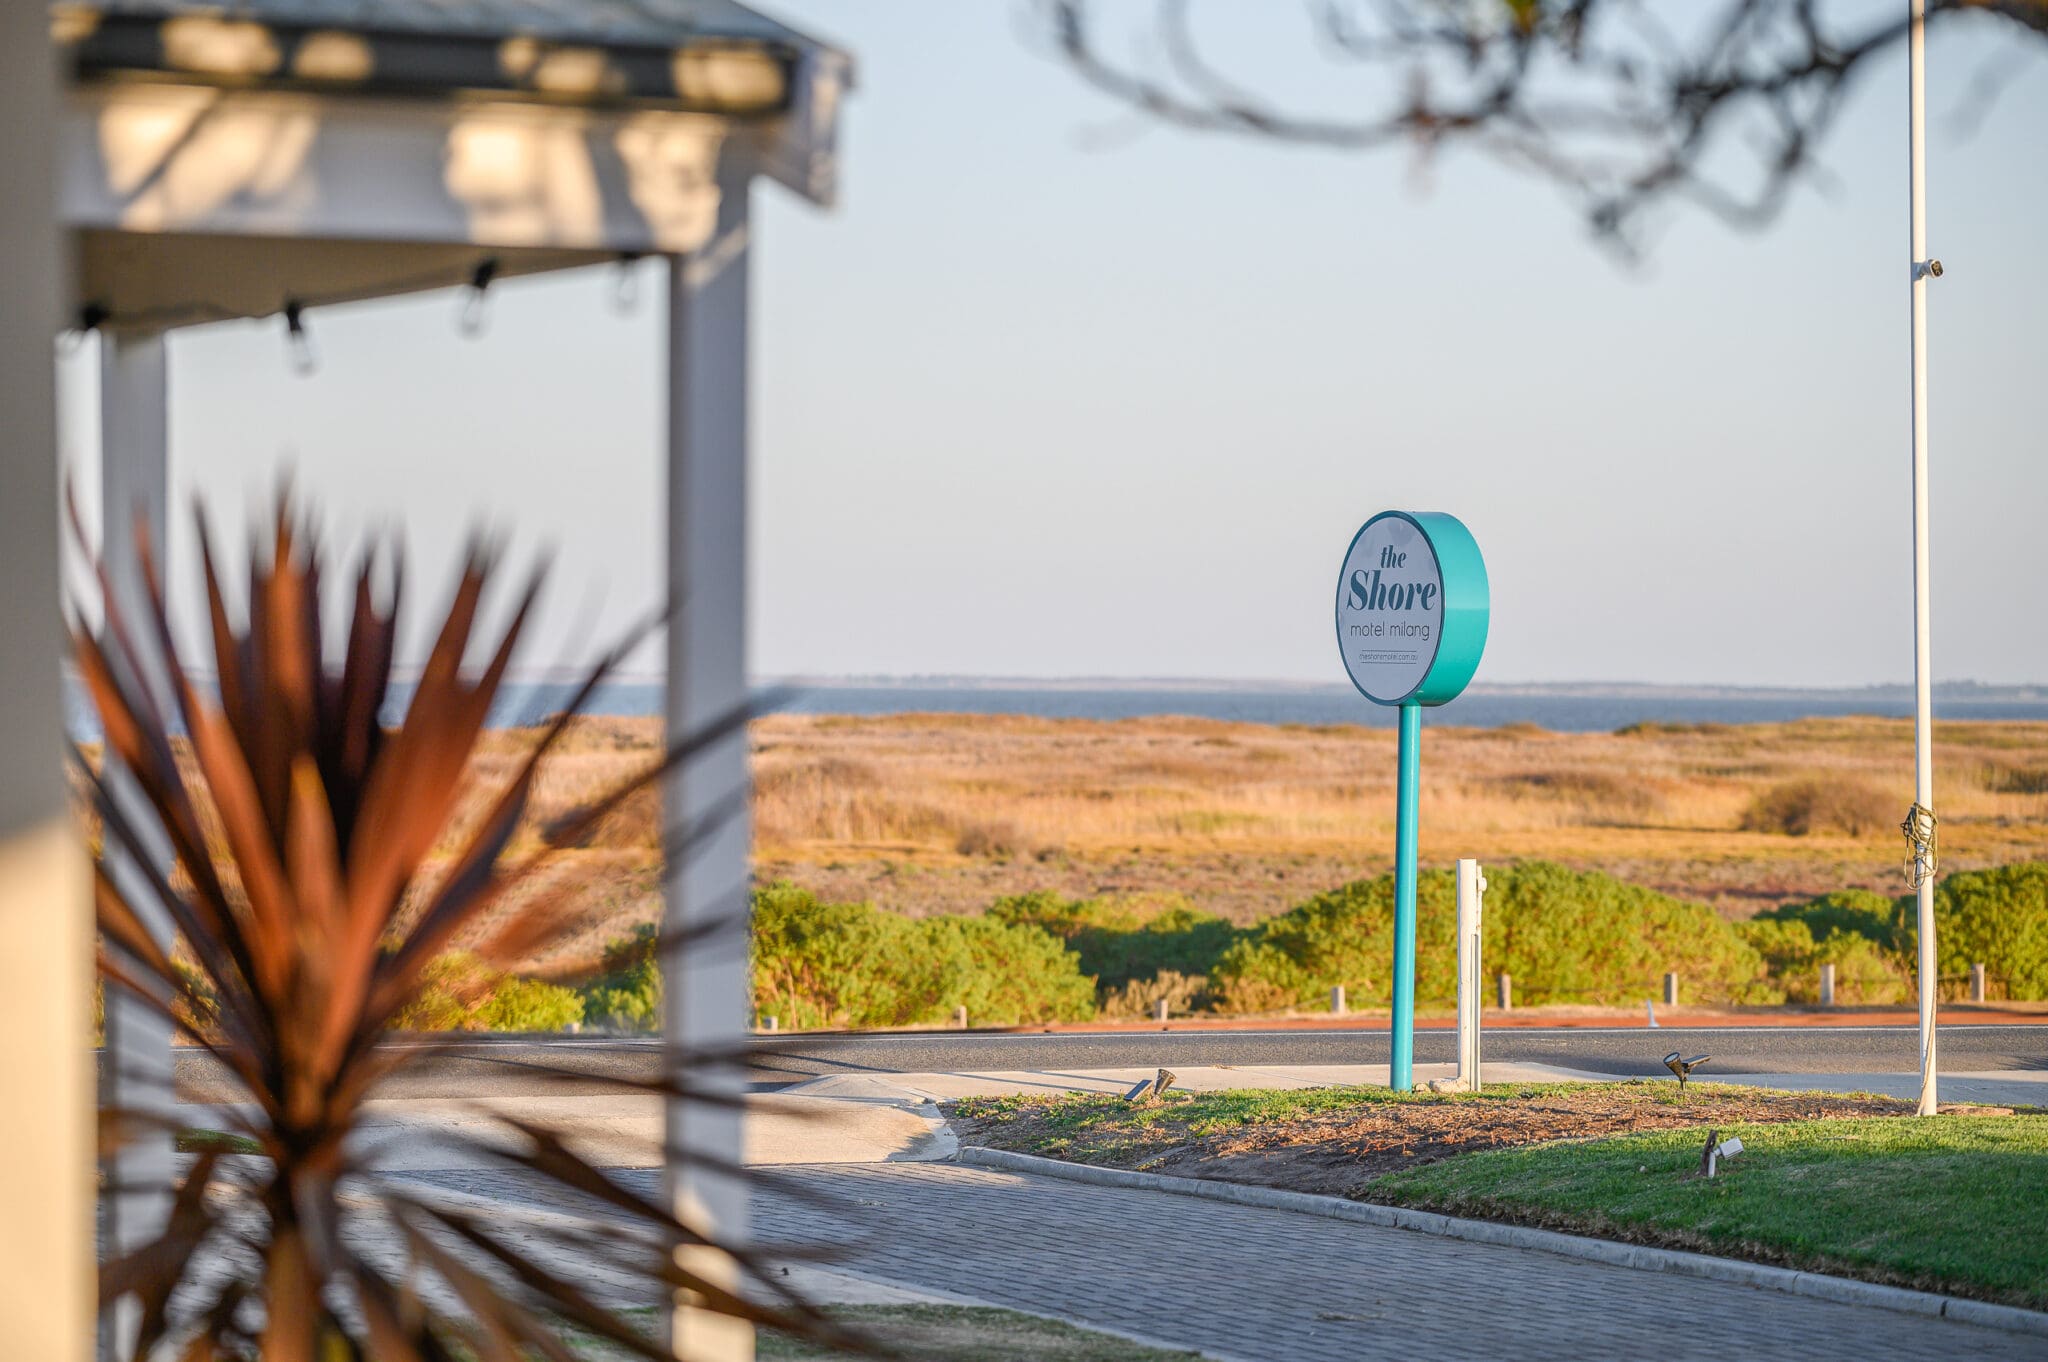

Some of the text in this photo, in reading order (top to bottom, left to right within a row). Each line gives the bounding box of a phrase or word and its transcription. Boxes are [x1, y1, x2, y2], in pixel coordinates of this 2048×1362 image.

[1380, 545, 1407, 568] the
[1346, 569, 1437, 611] Shore
[1350, 621, 1430, 641] motel milang
